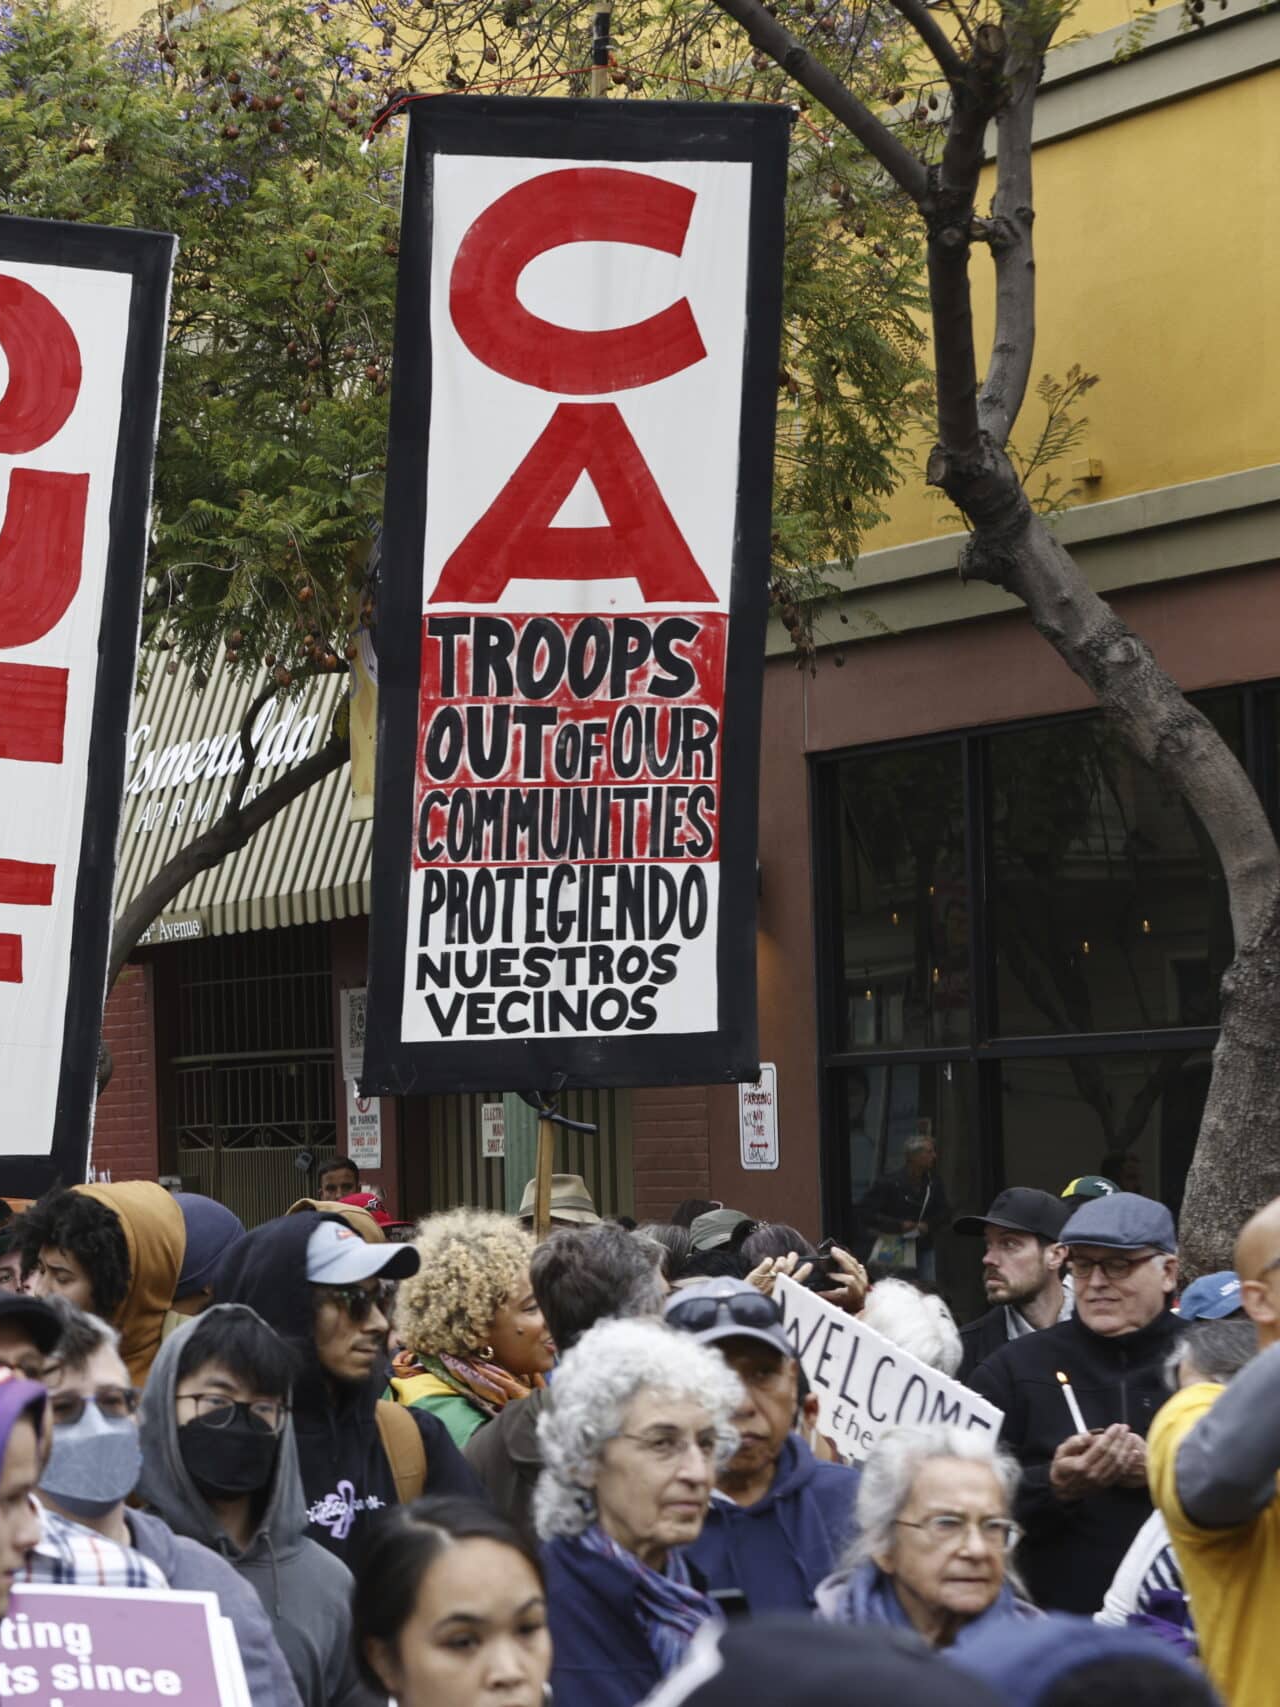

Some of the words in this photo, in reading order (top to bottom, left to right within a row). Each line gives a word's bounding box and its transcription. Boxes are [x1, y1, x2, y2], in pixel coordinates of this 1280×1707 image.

[427, 167, 720, 604] CA
[426, 616, 701, 700] TROOPS
[424, 704, 558, 781] OUT
[554, 722, 608, 780] OF
[611, 704, 718, 779] OUR
[419, 785, 716, 863] COMMUNITIES
[418, 863, 708, 947] PROTEGIENDO
[160, 919, 200, 941] Avenue
[416, 943, 681, 990] NUESTROS
[424, 985, 659, 1037] VECINOS
[350, 1115, 357, 1126] NO
[358, 1114, 378, 1125] PARKING
[743, 1091, 772, 1106] PARKING
[832, 1404, 874, 1450] the
[51, 1654, 183, 1697] since
